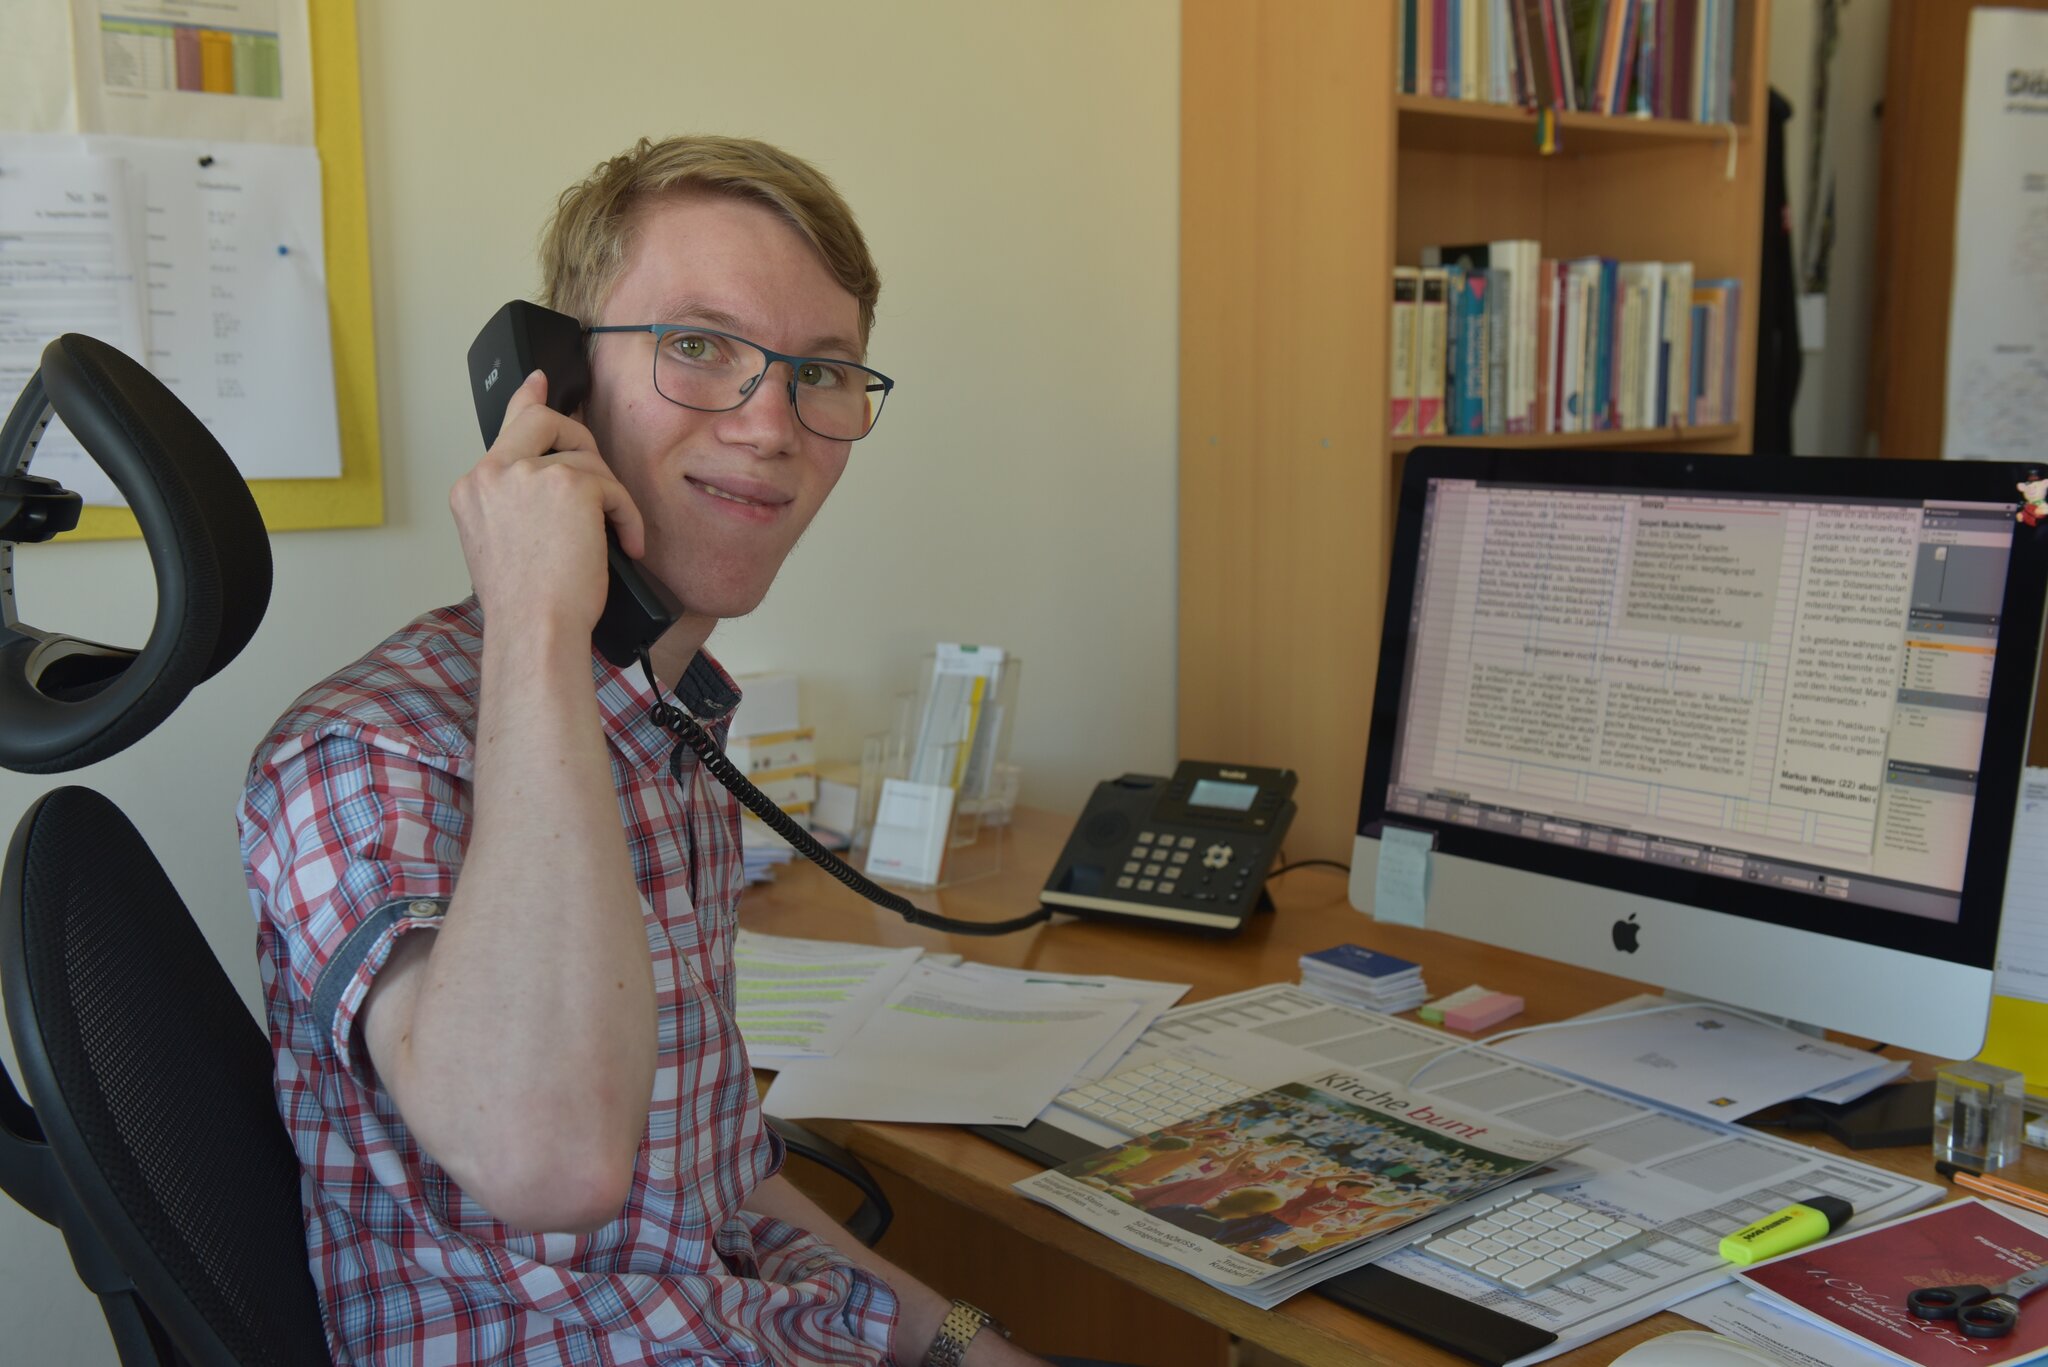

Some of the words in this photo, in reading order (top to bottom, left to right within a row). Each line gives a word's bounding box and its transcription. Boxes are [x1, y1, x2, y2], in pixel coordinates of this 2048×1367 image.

[484, 367, 499, 393] HD
[1781, 770, 1807, 782] Markus
[1810, 775, 1835, 786] Winzer
[1838, 779, 1855, 789] (22)
[1779, 782, 1816, 795] monatiges
[1818, 788, 1857, 801] Praktikum
[1858, 795, 1871, 804] bei
[1315, 1073, 1409, 1111] Kirche
[1406, 1105, 1488, 1140] bunt
